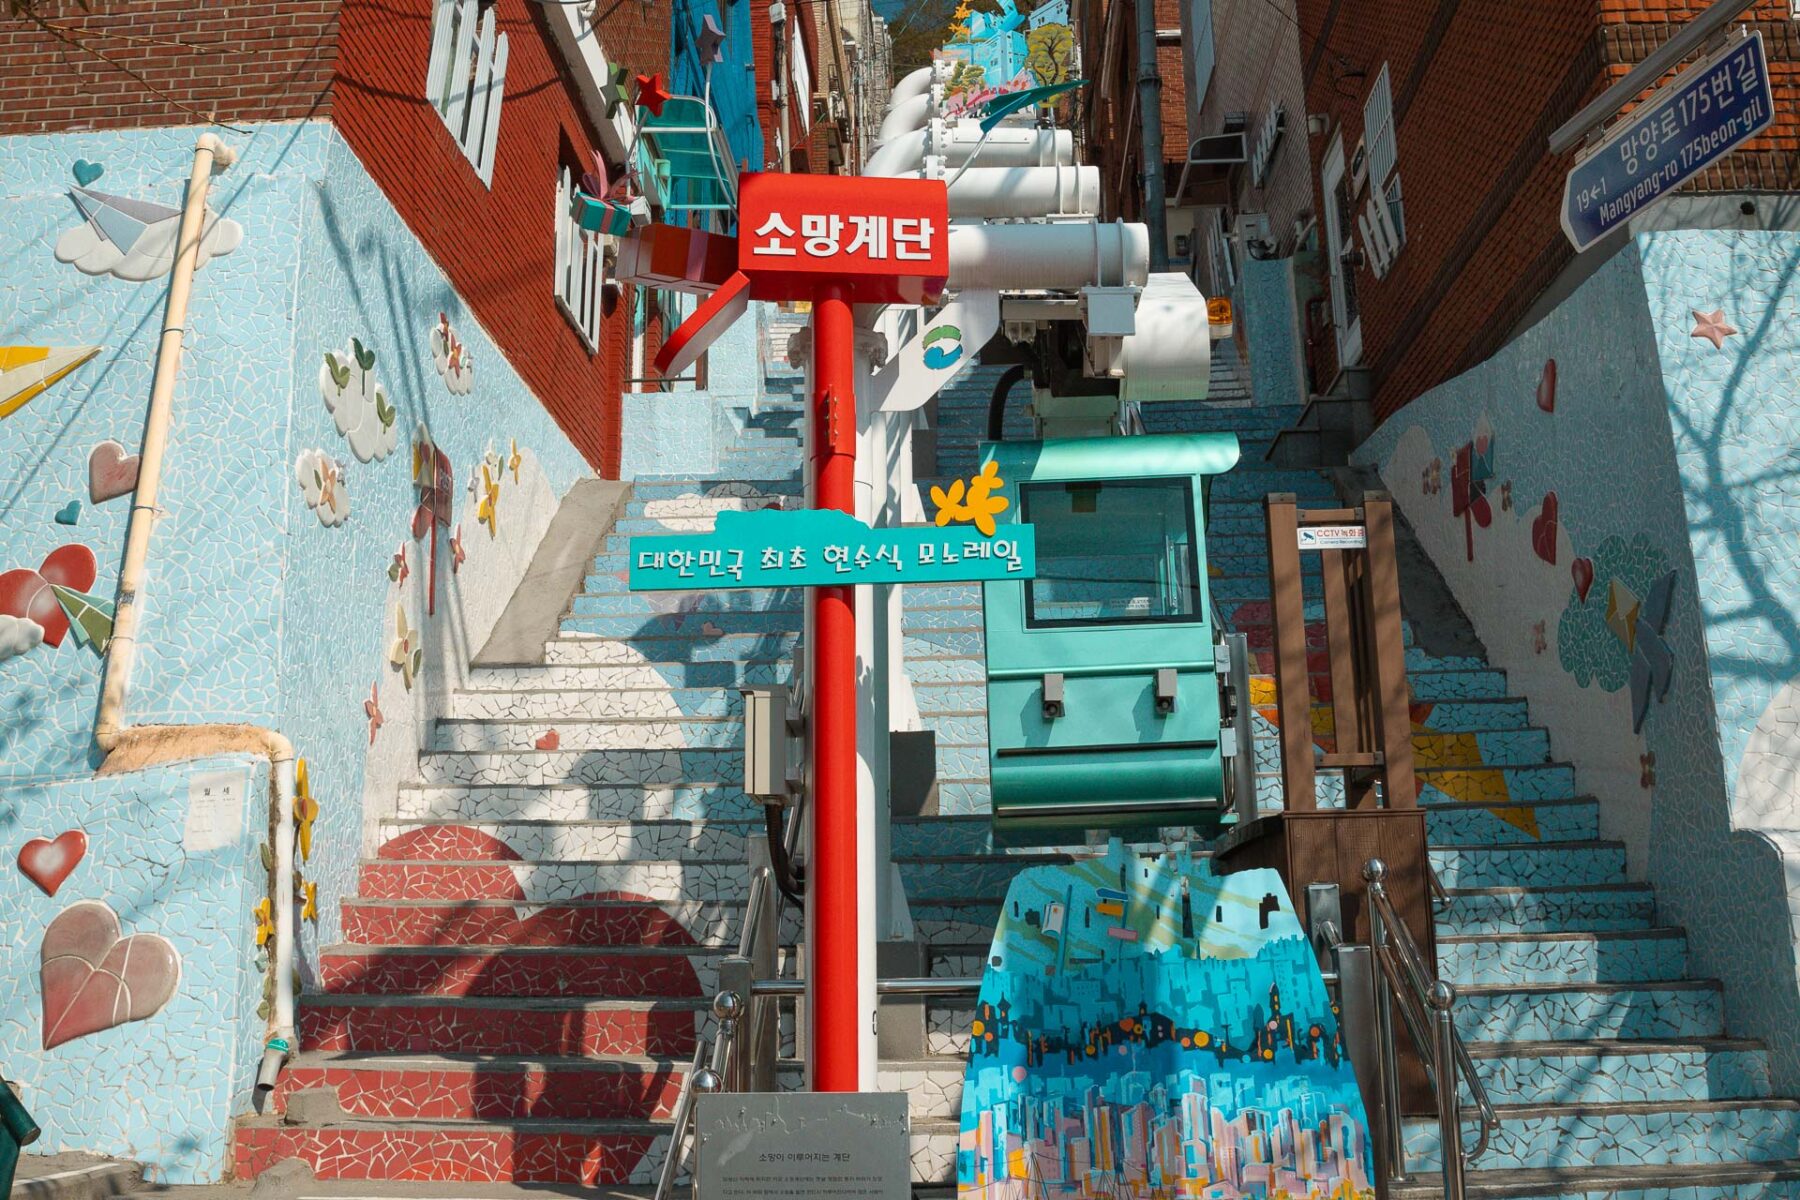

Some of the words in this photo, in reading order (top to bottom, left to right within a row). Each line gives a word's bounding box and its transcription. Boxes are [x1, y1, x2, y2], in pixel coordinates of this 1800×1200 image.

[1620, 47, 1759, 175] 망양로175번길
[1600, 159, 1678, 226] Mangyang-ro
[1679, 95, 1763, 169] 175beon-gil
[1576, 189, 1590, 213] 19
[753, 212, 935, 260] 소망계단
[1316, 529, 1340, 537] CCTV
[637, 548, 744, 581] 대한민국
[760, 545, 807, 571] 최초
[823, 543, 903, 574] 현수식
[917, 538, 1024, 572] 모노레일
[759, 1152, 785, 1163] 소망이
[787, 1152, 830, 1163] 이루어지는
[833, 1152, 850, 1162] 계단
